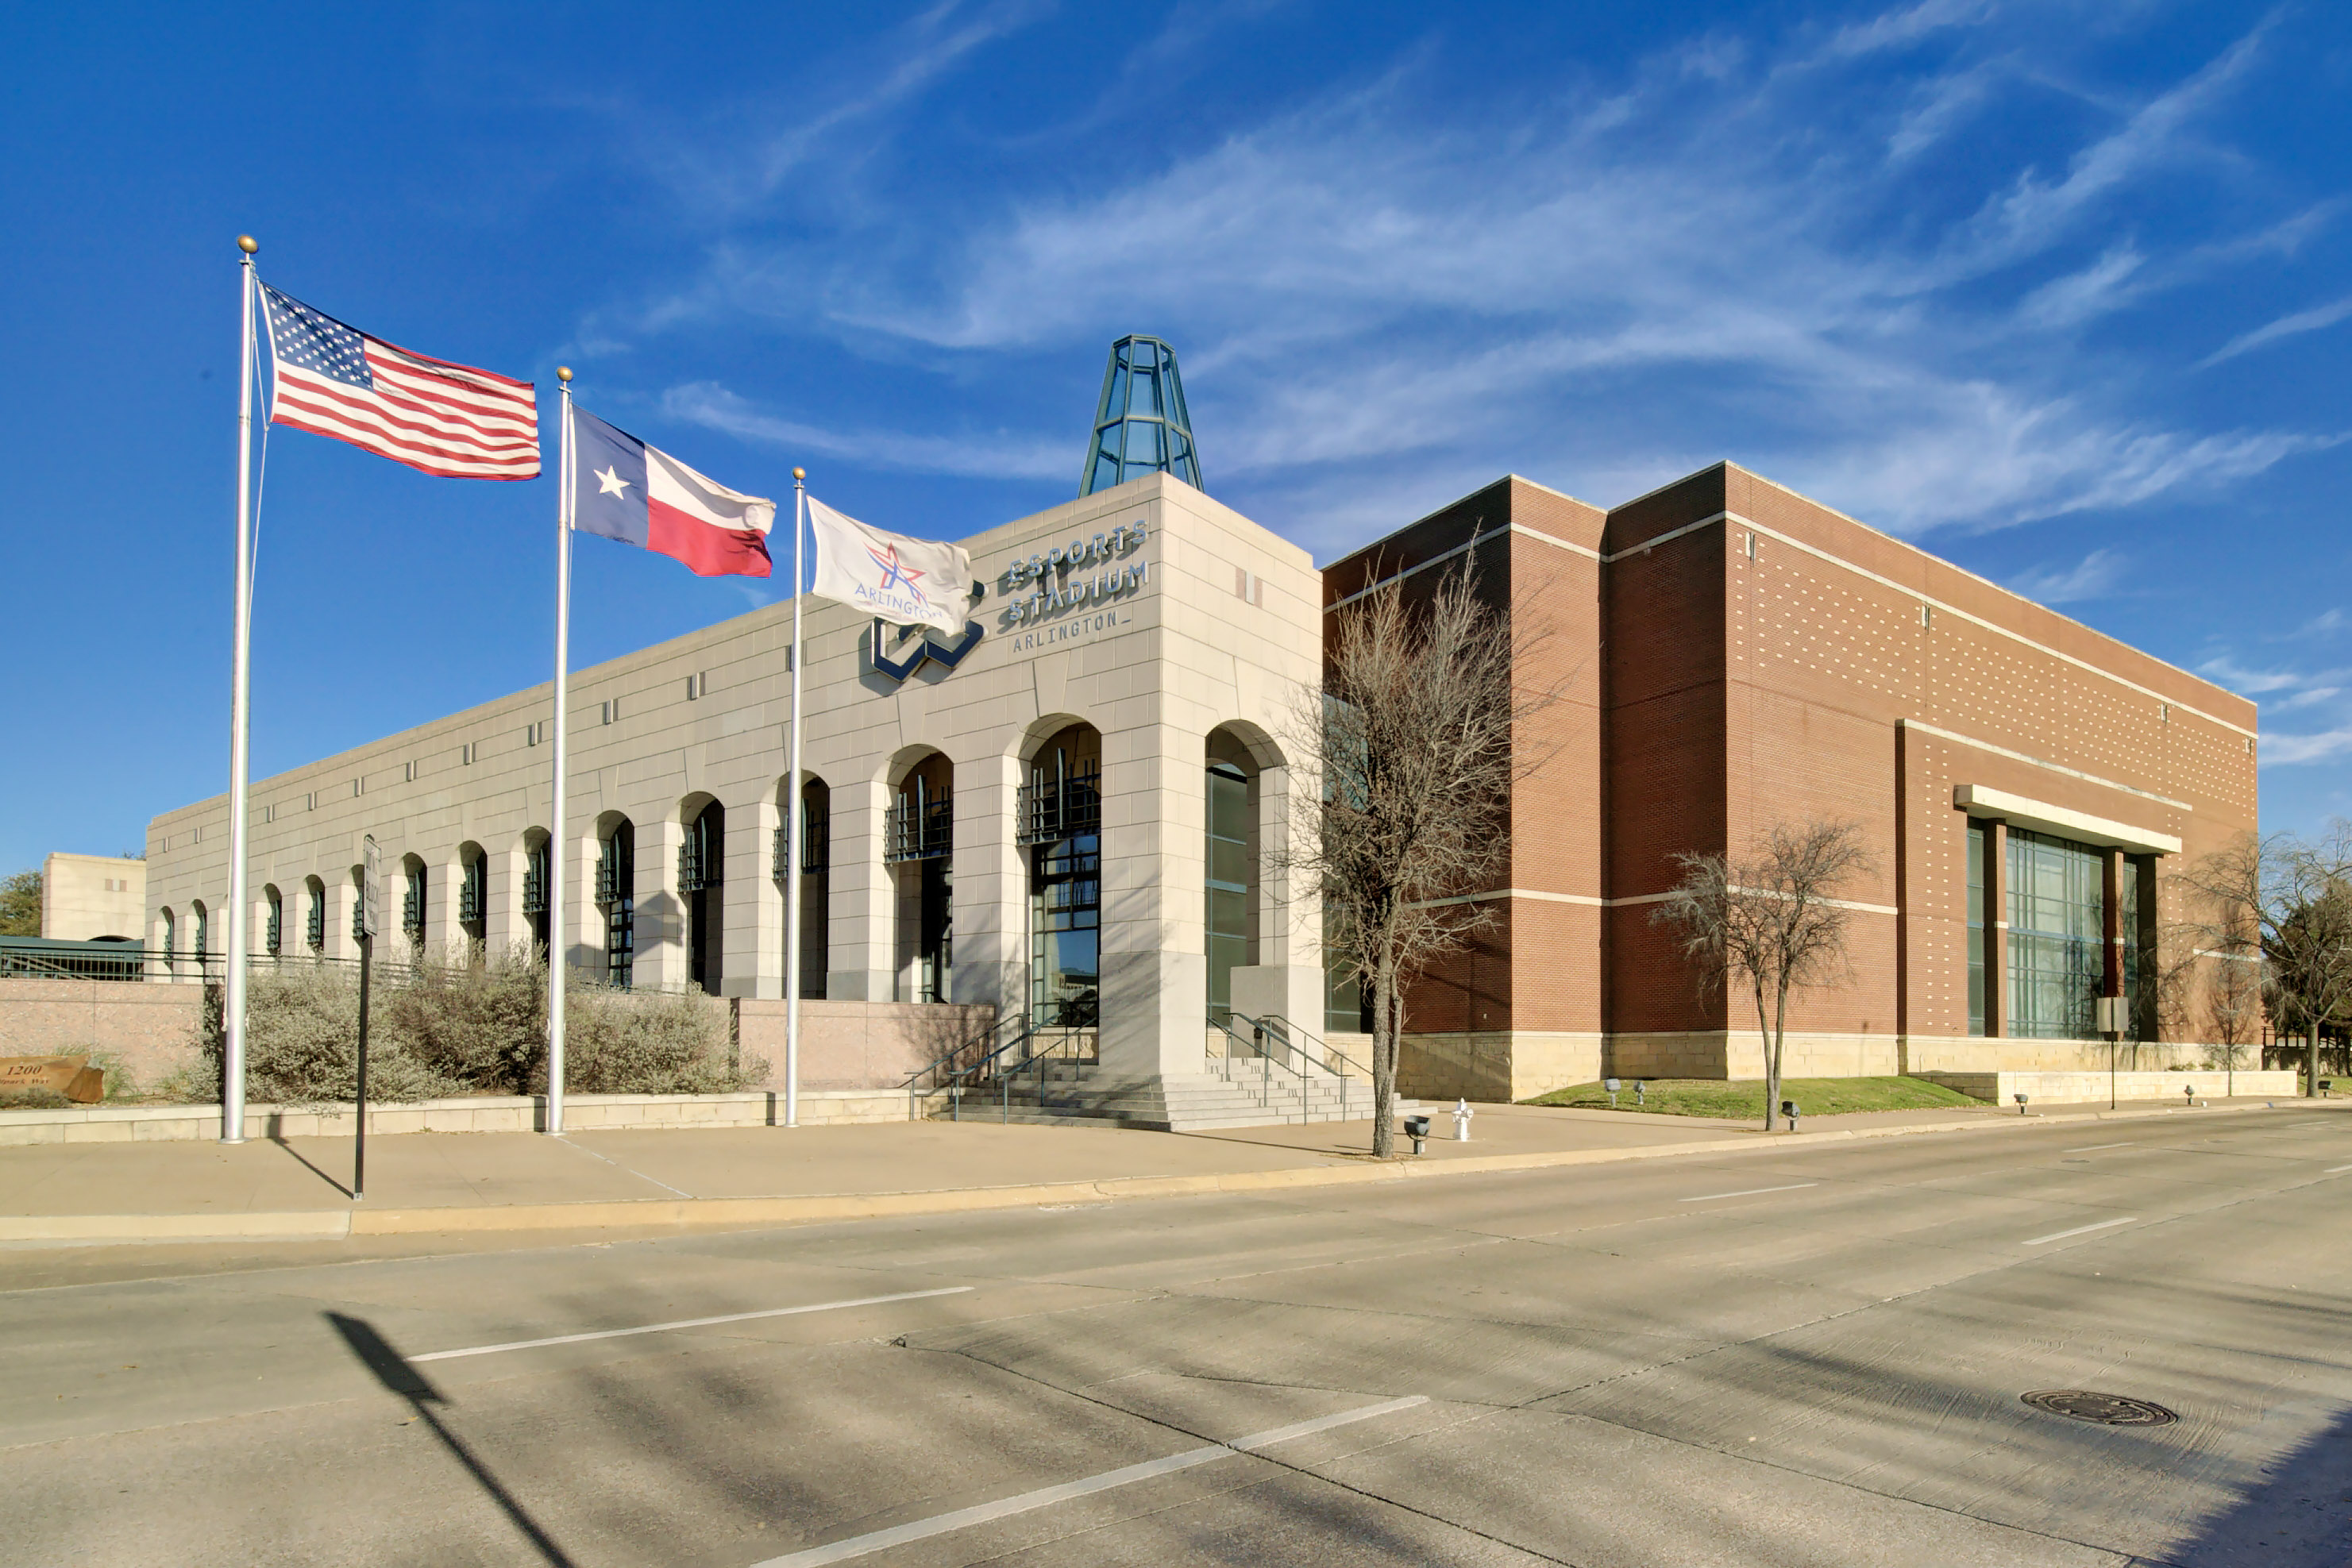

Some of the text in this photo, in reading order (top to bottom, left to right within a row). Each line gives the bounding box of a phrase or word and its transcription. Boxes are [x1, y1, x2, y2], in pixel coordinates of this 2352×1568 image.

[1008, 520, 1147, 588] ESPORTS
[1009, 561, 1148, 621] STADIUM
[7, 1065, 42, 1076] 1200
